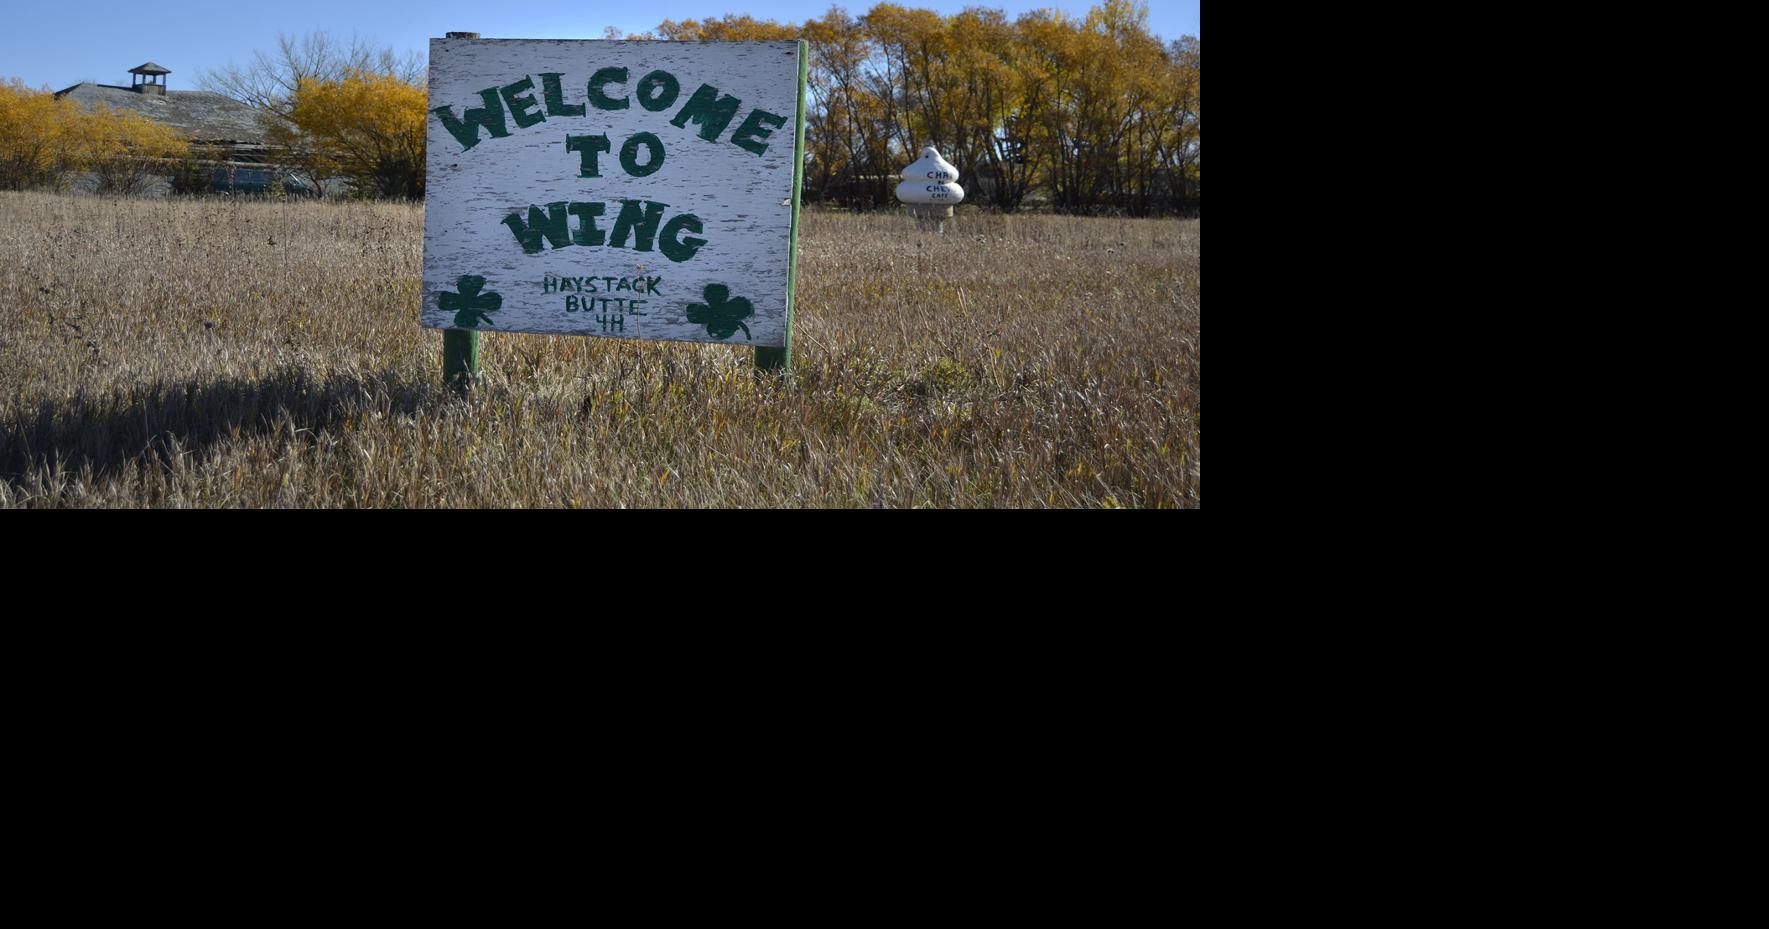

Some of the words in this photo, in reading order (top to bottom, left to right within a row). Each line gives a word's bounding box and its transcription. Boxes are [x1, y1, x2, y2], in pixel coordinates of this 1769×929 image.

[431, 66, 788, 157] WELCOME
[565, 131, 666, 178] TO
[500, 200, 708, 262] WING
[543, 276, 661, 296] HAYSTACK
[565, 295, 648, 316] BUTTE
[596, 314, 624, 332] 4H
